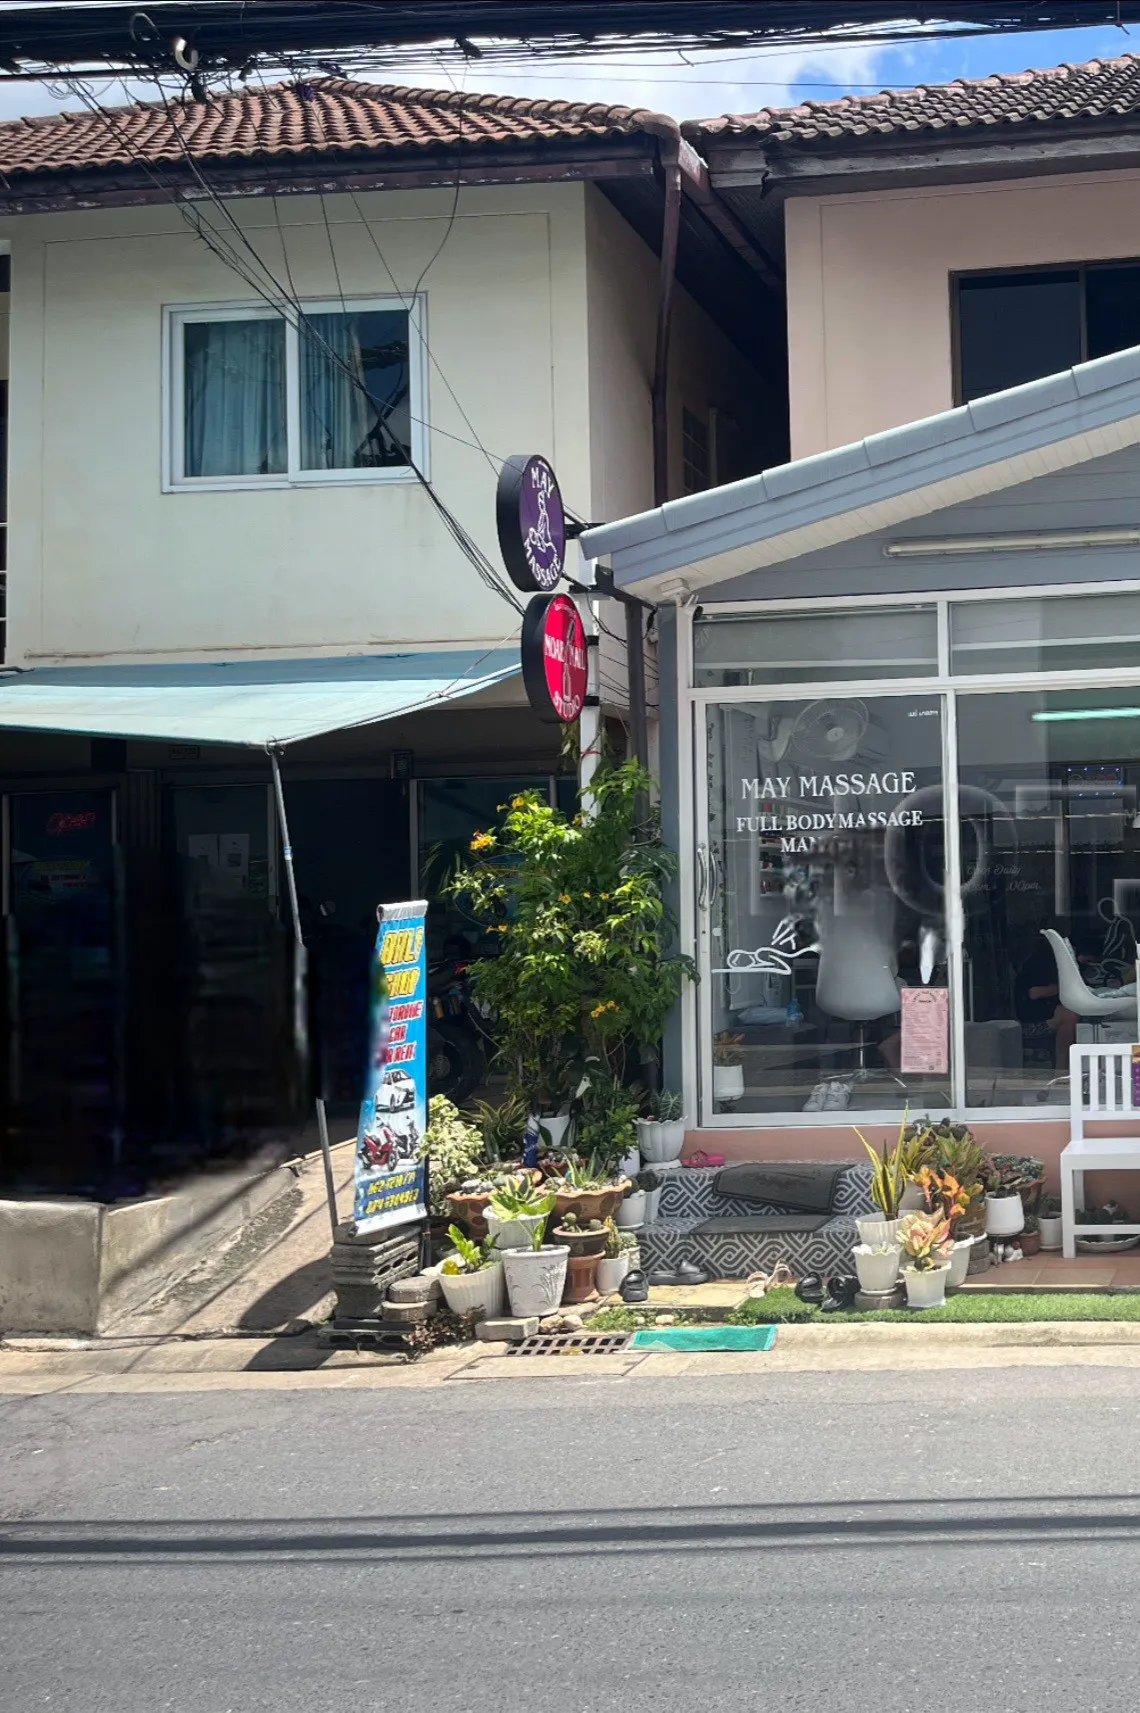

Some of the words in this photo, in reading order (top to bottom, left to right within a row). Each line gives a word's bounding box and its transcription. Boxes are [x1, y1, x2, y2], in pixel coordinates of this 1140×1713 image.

[530, 466, 555, 499] MAY
[523, 536, 561, 587] MASSAGE
[553, 690, 581, 719] STUDIO
[741, 777, 792, 800] MAY
[799, 771, 917, 797] MASSAGE
[736, 816, 783, 832] FULL
